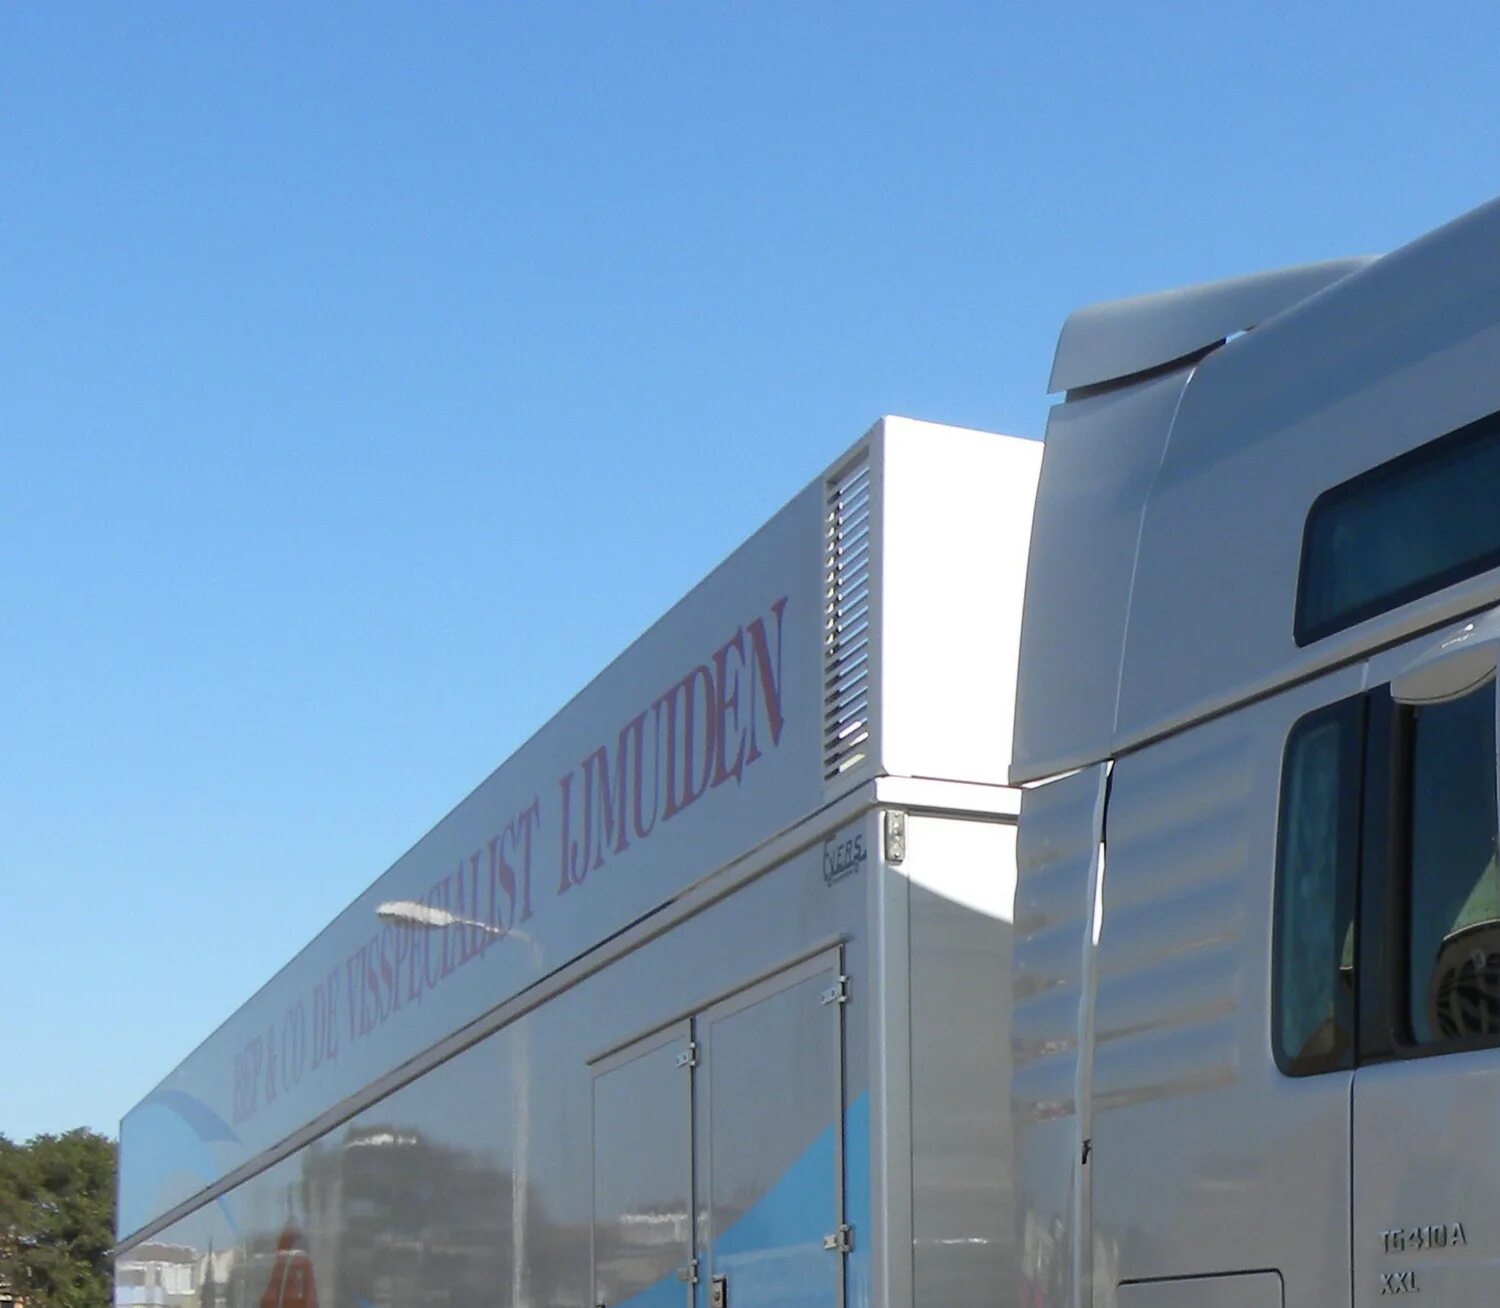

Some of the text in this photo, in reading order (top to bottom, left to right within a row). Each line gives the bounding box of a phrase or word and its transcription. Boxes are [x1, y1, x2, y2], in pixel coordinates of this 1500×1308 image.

[313, 965, 340, 1070] DE
[346, 794, 541, 1041] VISSPECIALIST
[557, 596, 788, 895] IJMUIDEN
[1380, 1271, 1420, 1295] XXL
